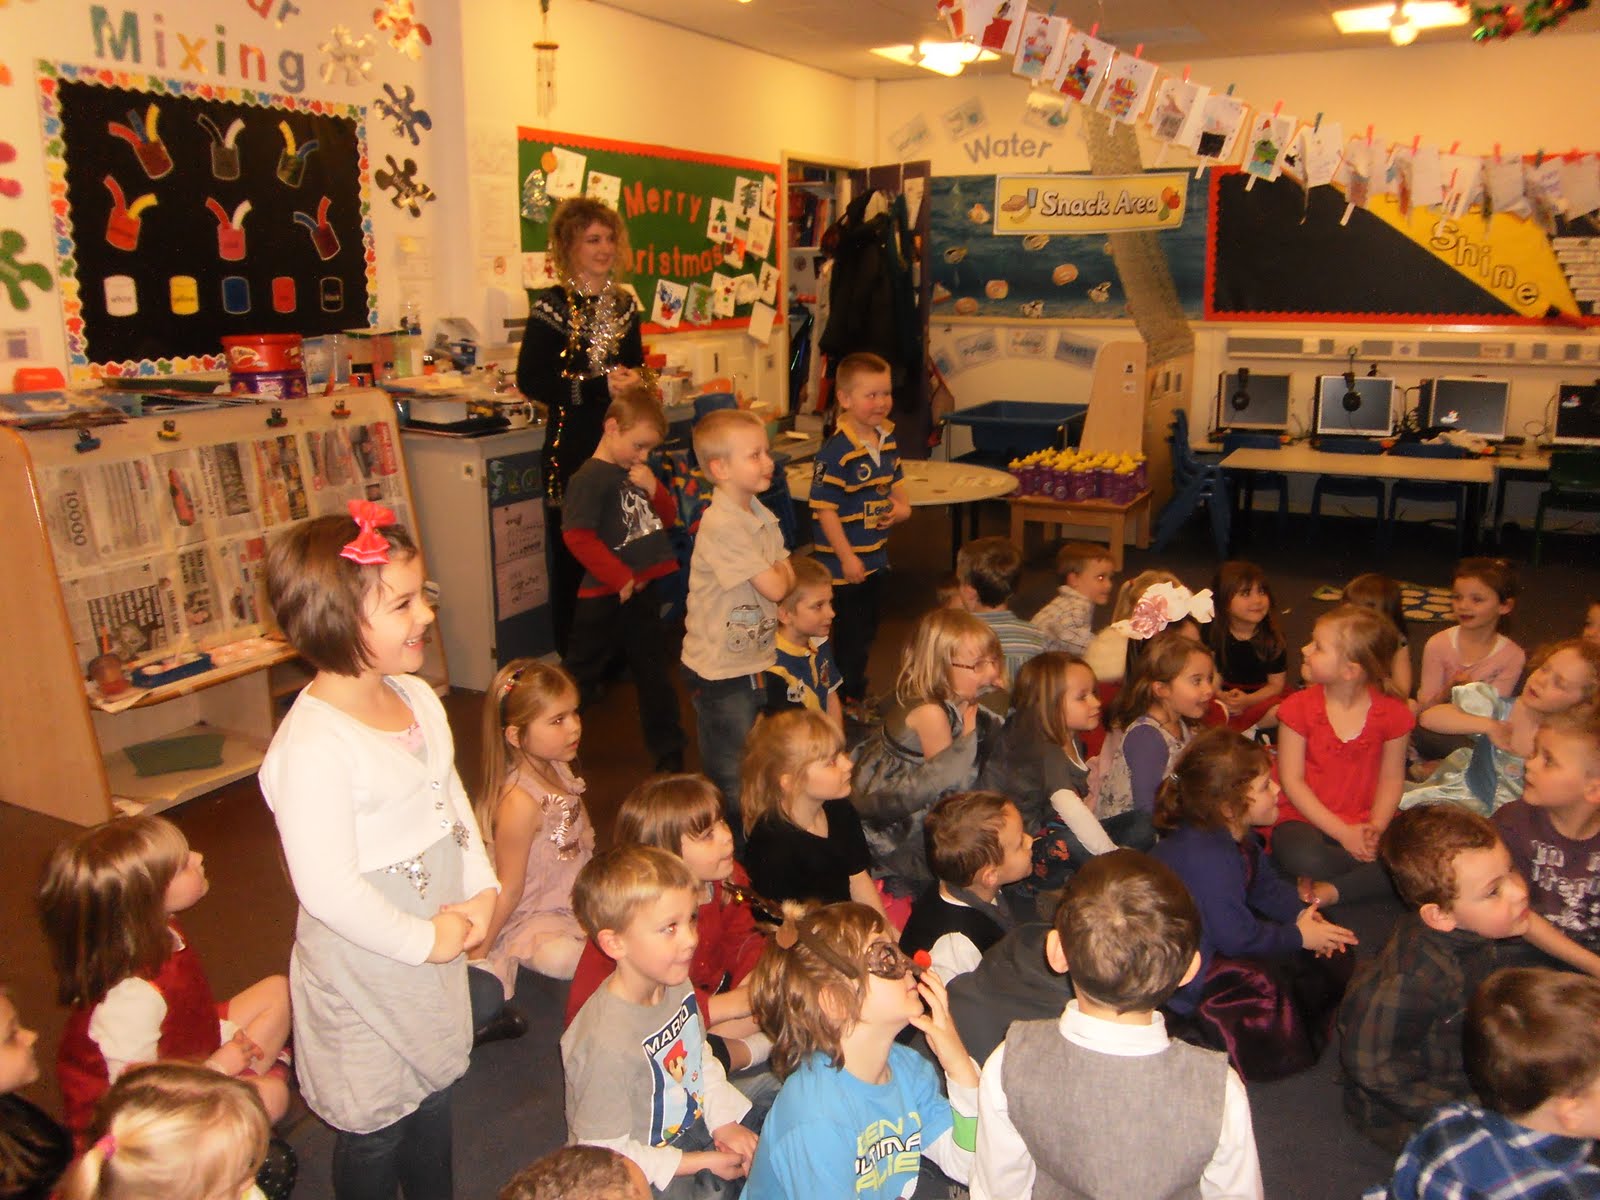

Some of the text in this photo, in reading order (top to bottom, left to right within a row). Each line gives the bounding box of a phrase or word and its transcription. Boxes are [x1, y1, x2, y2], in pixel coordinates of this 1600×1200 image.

[90, 5, 305, 93] Mixing
[965, 131, 1053, 163] Water
[623, 180, 703, 224] Merry
[1041, 188, 1158, 217] Snack Area
[624, 242, 724, 277] ristmas
[1429, 219, 1539, 306] Shine
[645, 1004, 689, 1056] MARIO
